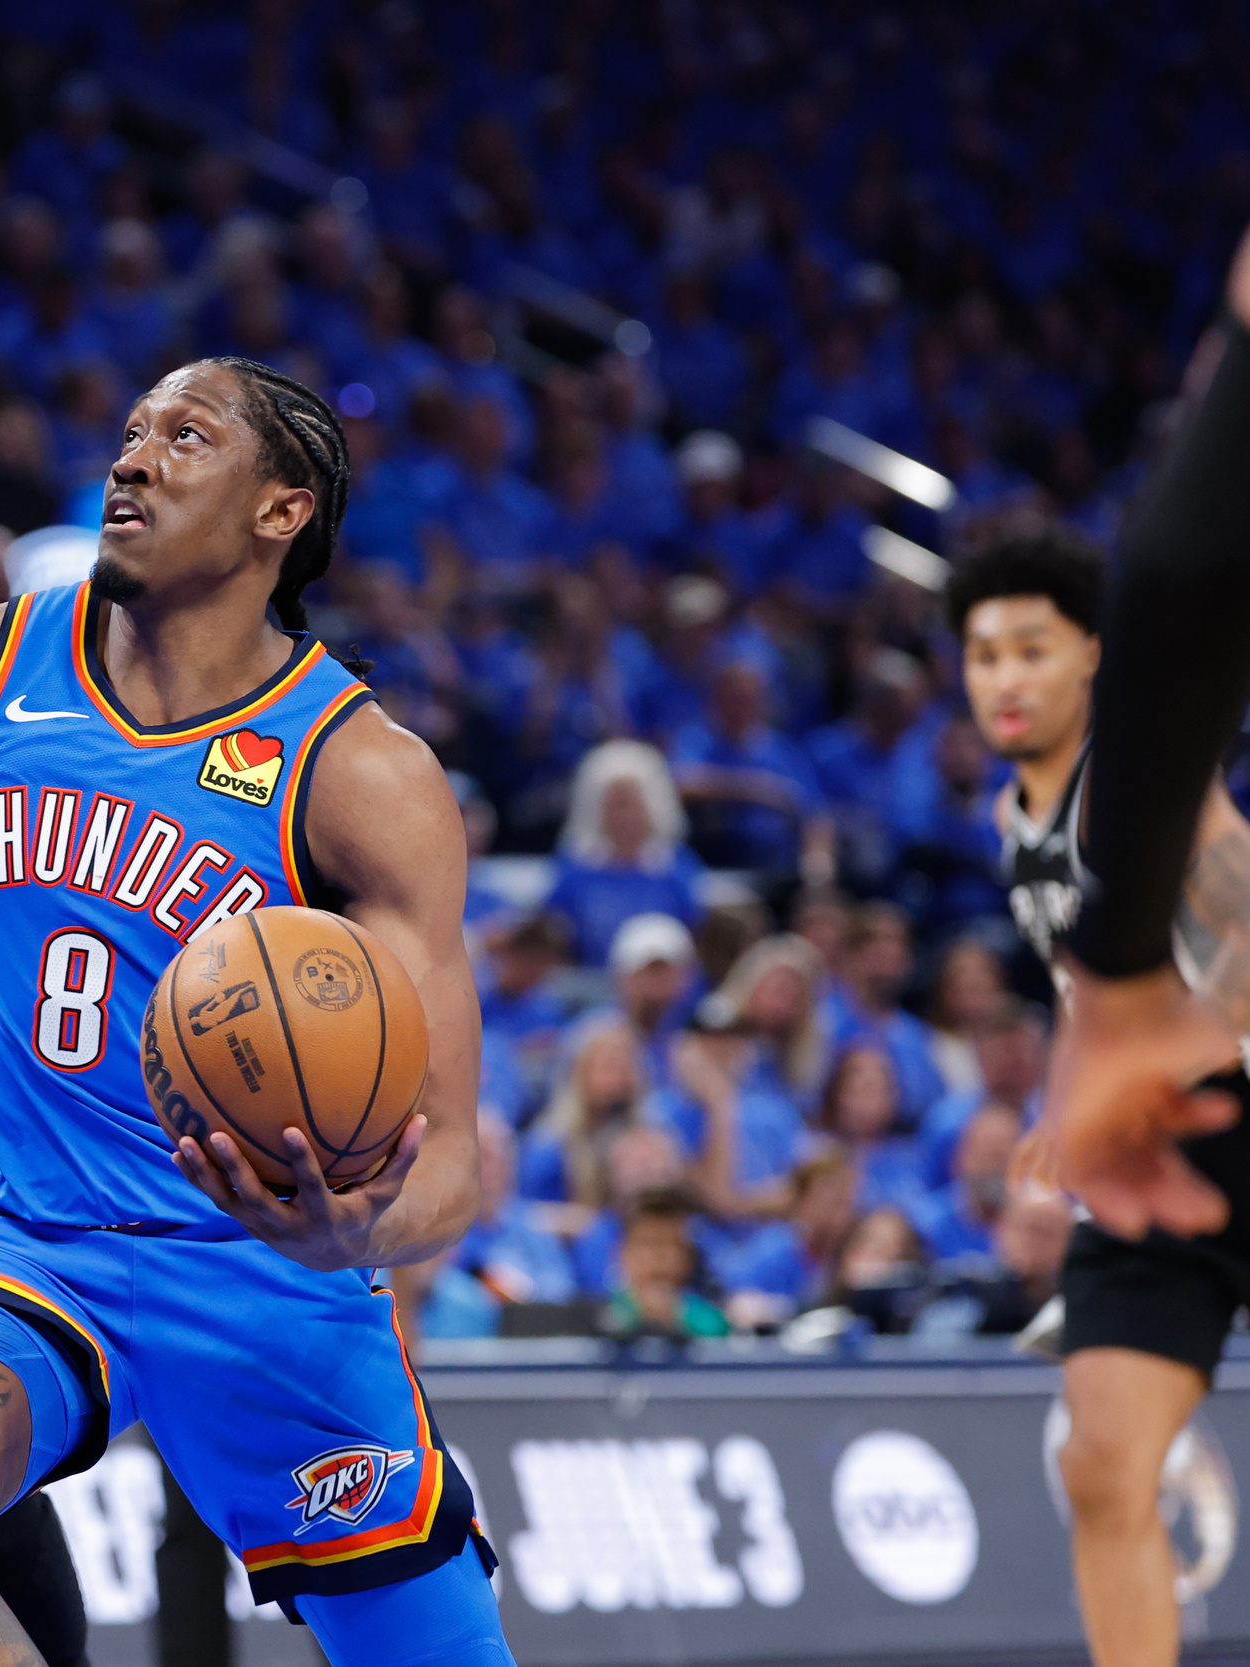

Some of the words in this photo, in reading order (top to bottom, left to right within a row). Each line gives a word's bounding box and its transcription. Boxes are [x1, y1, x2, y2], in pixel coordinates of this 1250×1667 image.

[32, 926, 116, 1073] 8
[307, 1457, 368, 1519] OKC
[713, 1433, 805, 1608] 3
